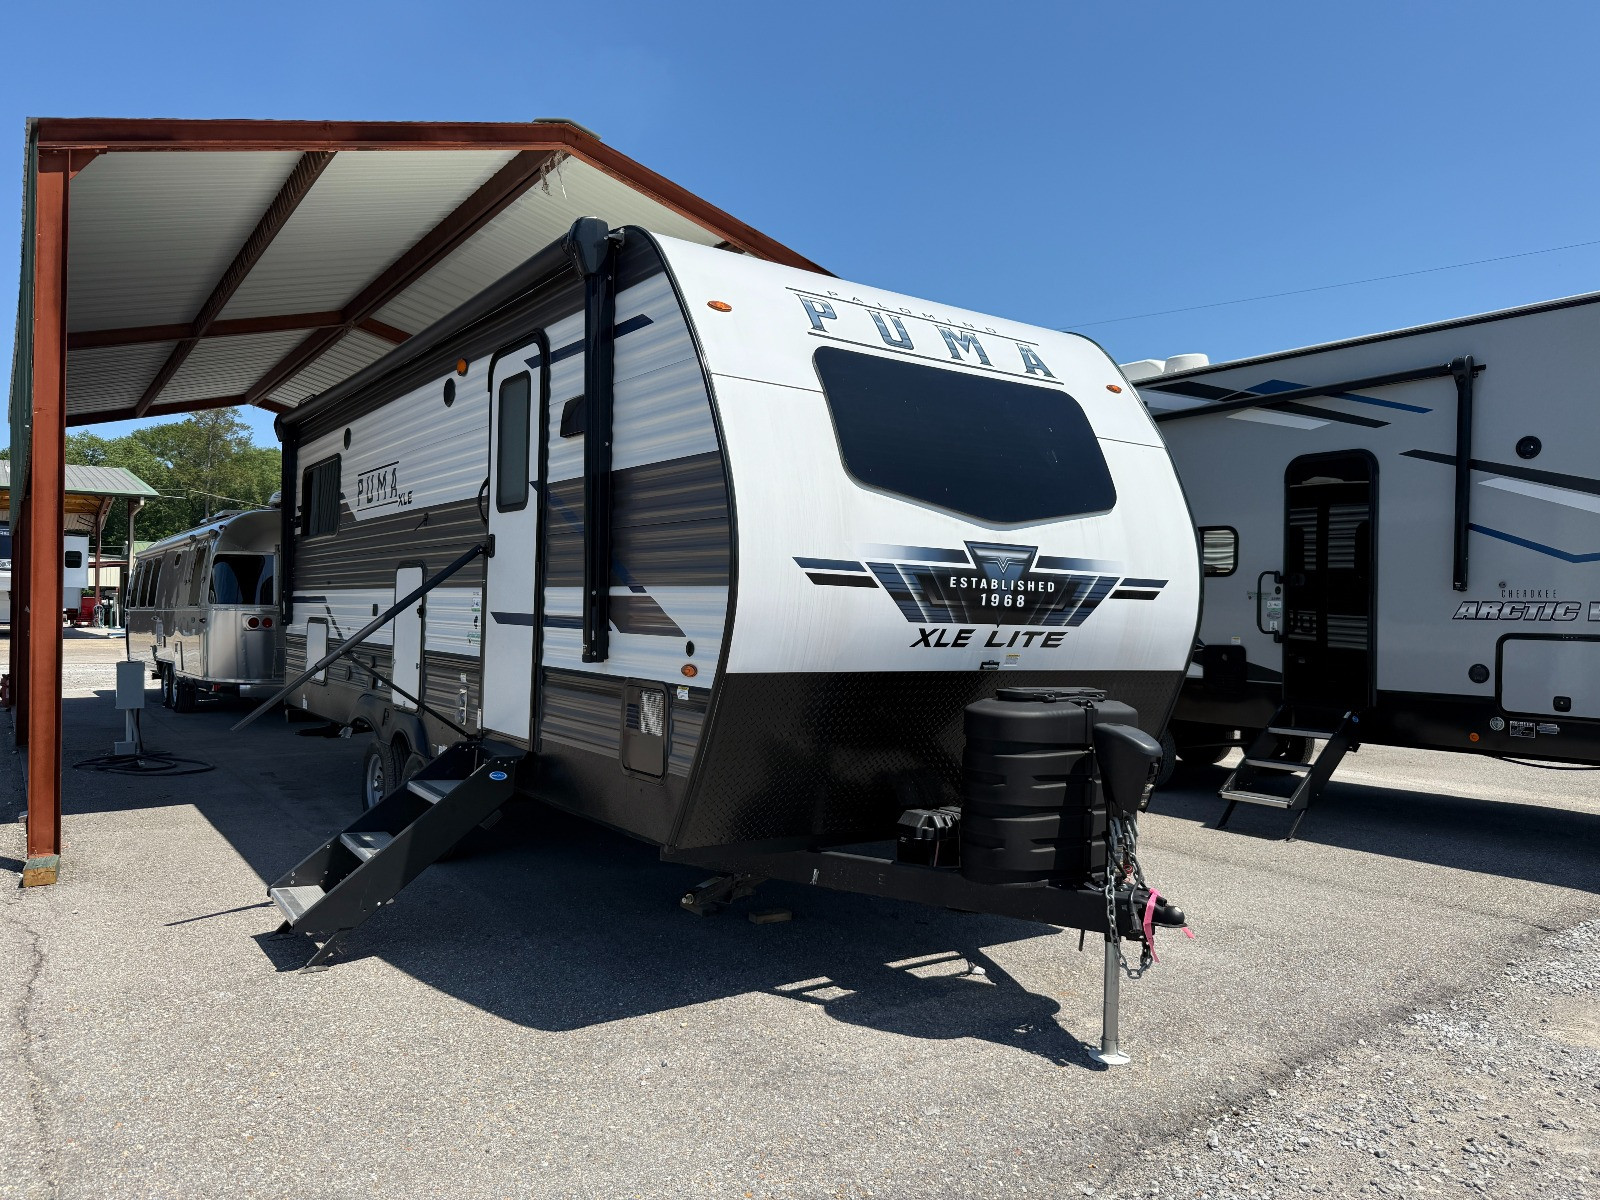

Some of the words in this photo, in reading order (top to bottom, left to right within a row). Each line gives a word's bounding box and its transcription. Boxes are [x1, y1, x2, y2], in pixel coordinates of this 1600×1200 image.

[827, 290, 997, 334] PALOMINO
[793, 293, 1058, 379] PUMA
[356, 467, 397, 507] PUMA
[397, 490, 413, 507] XLE
[949, 576, 1055, 593] ESTABLISHED
[1501, 589, 1557, 599] CHEROKEE
[980, 593, 1025, 607] 1968
[1452, 601, 1582, 622] ARCTIC
[909, 627, 977, 648] XLE
[983, 630, 1069, 649] LITE
